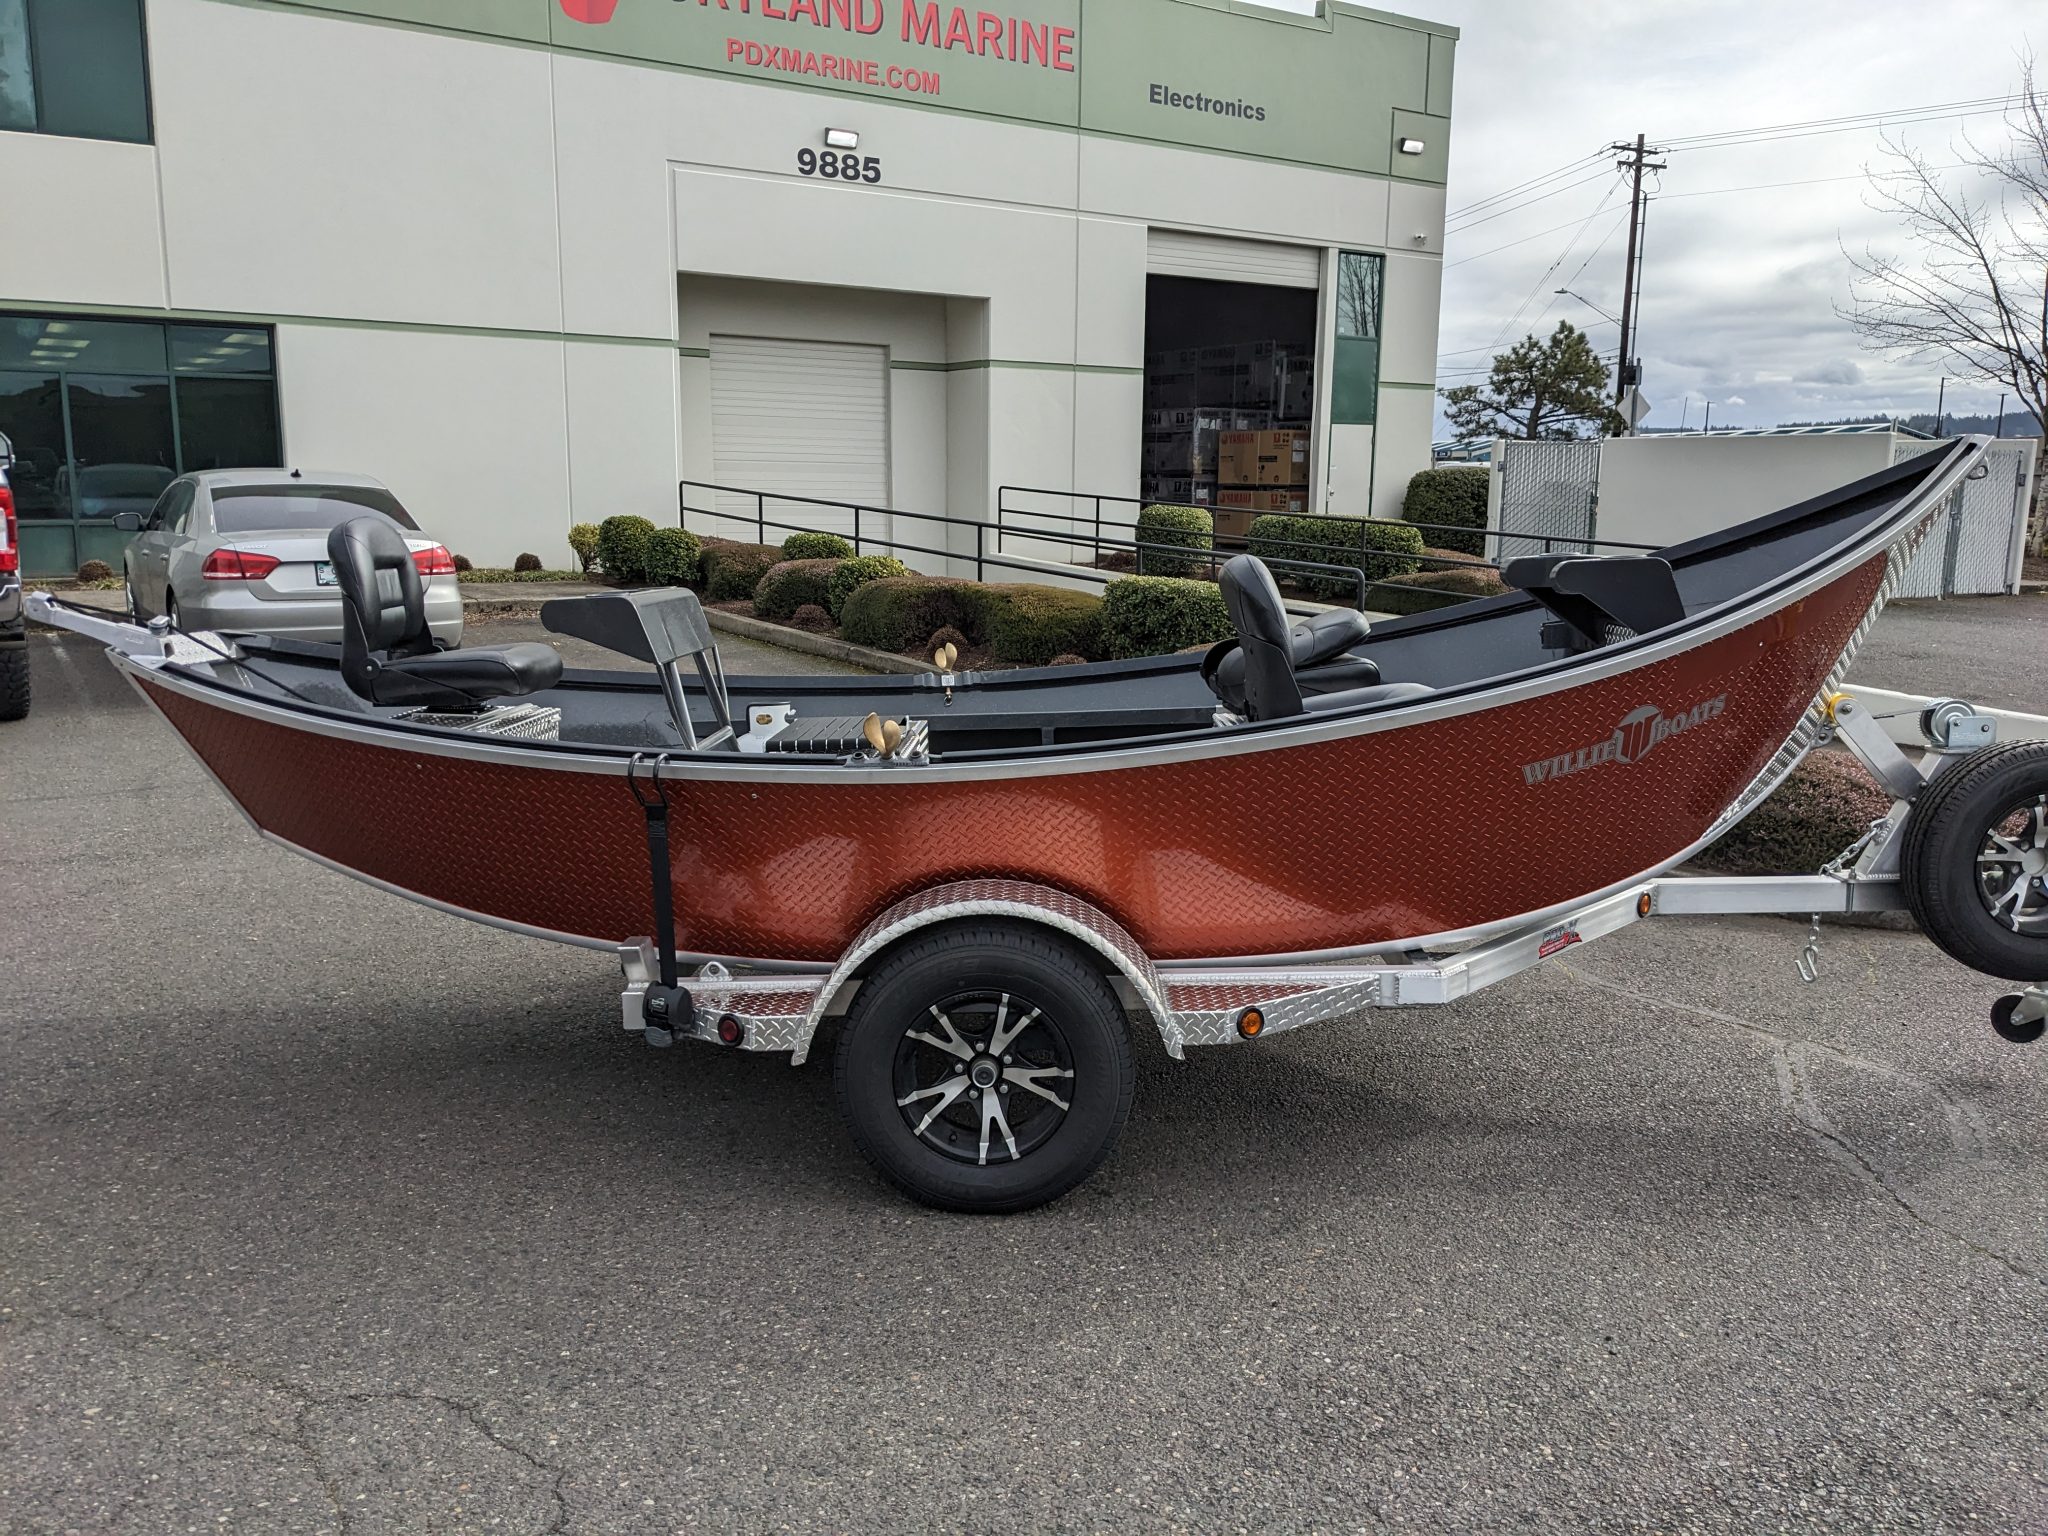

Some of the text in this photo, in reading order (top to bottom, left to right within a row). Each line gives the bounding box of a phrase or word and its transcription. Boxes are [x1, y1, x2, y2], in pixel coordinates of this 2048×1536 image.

[901, 0, 1075, 72] MARINE
[726, 38, 940, 95] PDXMARINE.COM
[1149, 83, 1266, 122] Electronics
[797, 147, 881, 183] 9885
[1522, 693, 1728, 785] WILLIE BOATS
